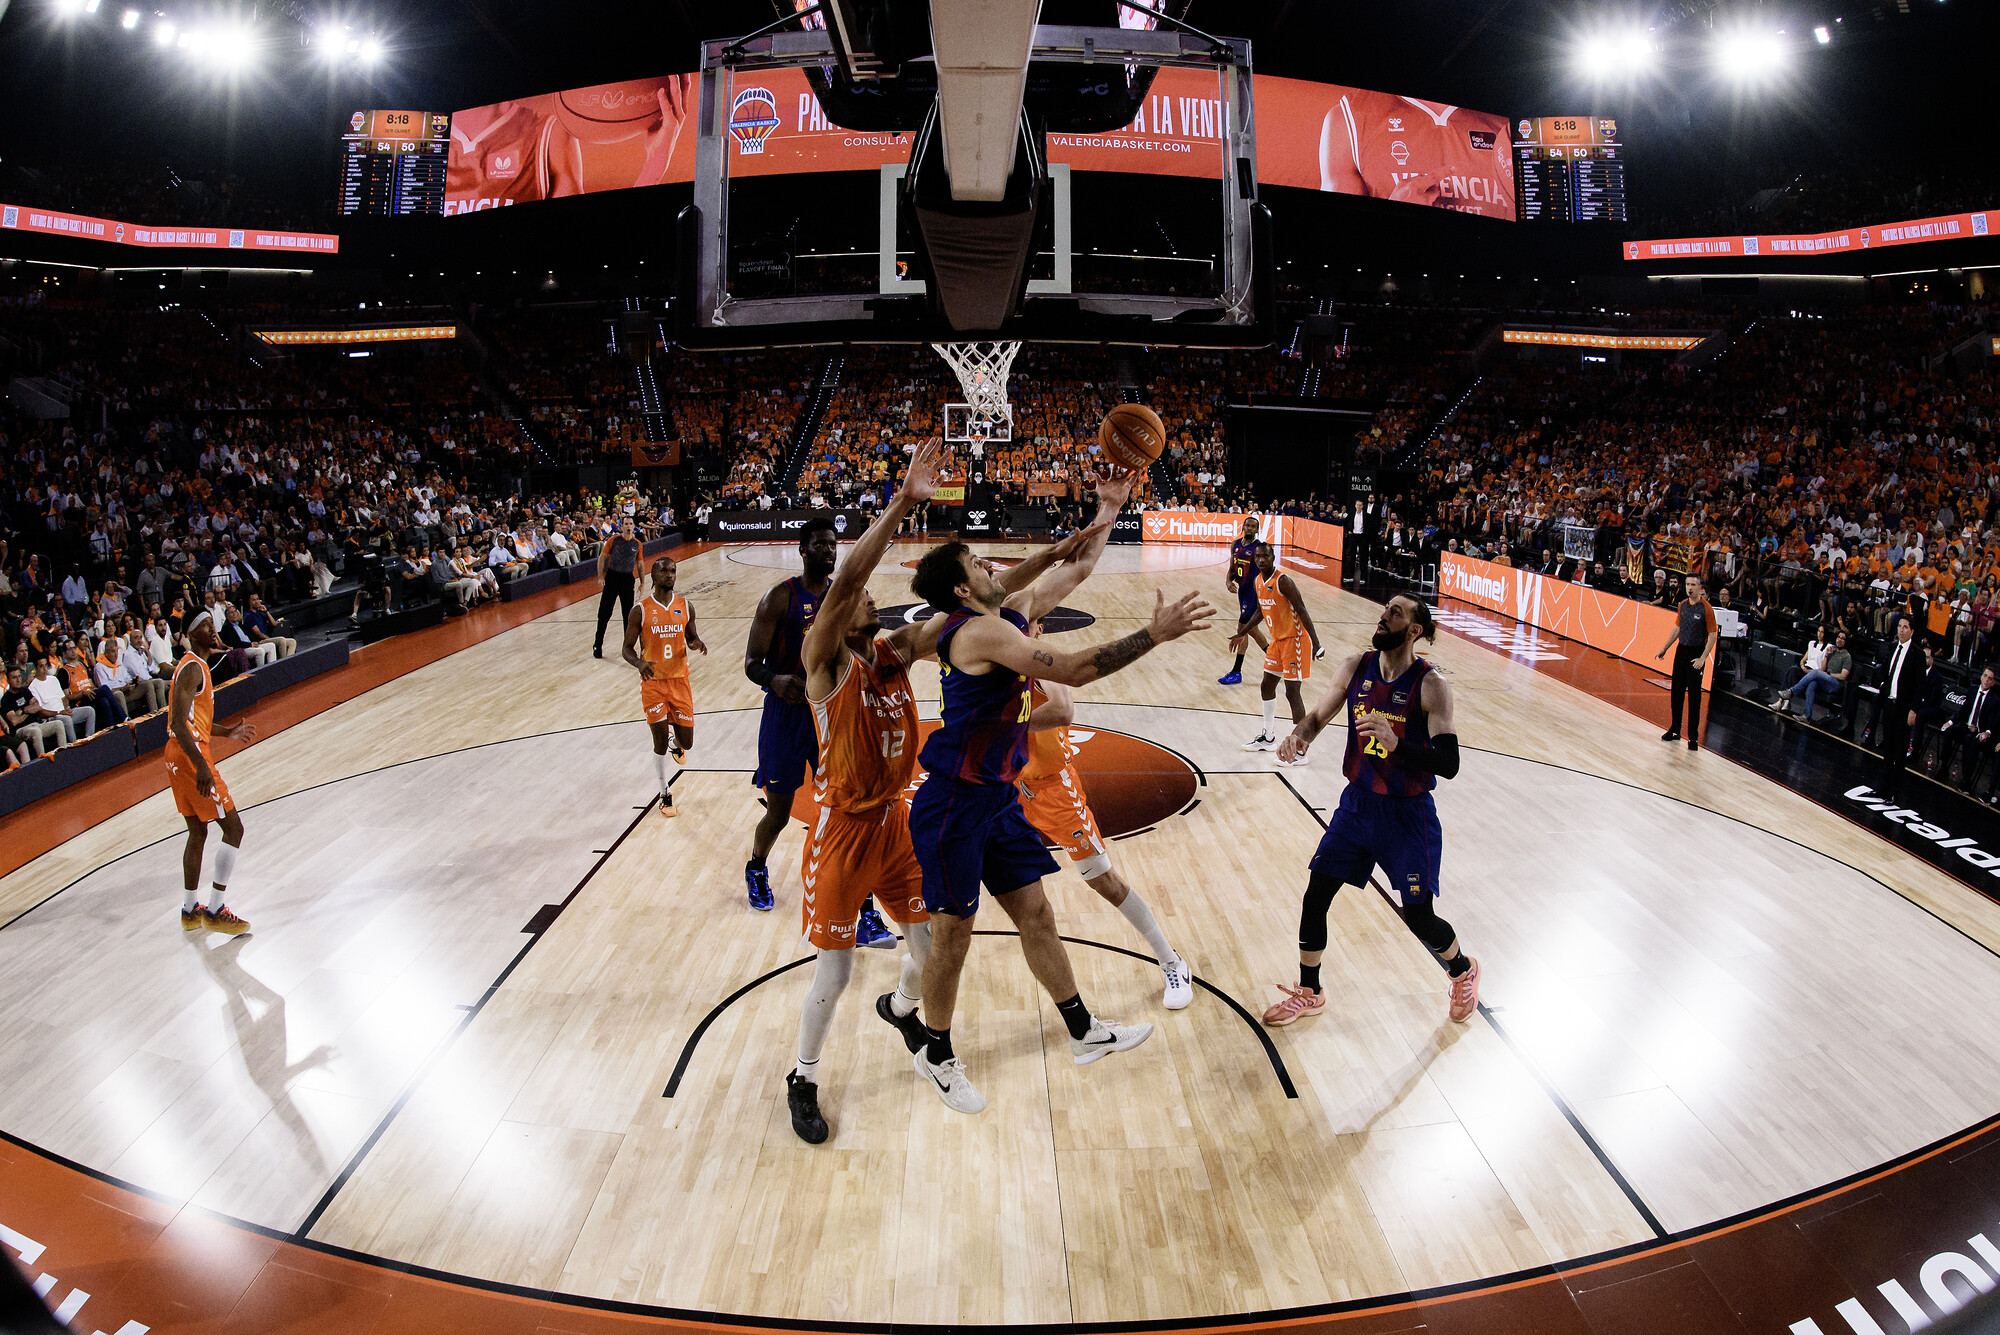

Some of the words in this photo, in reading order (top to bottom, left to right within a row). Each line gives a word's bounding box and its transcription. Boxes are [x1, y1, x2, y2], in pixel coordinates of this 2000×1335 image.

[386, 114, 409, 124] 8:18
[1152, 94, 1174, 134] LA
[1179, 97, 1230, 140] VENT
[1554, 120, 1576, 130] 8:18
[377, 142, 390, 151] 54
[401, 142, 415, 152] 50
[844, 136, 908, 147] CONSULTA
[1052, 136, 1191, 152] VALENCIABASKET.COM
[1549, 148, 1563, 158] 54
[1573, 148, 1587, 157] 50
[1111, 432, 1146, 466] Wilson
[726, 522, 771, 532] quironsalud
[1170, 518, 1238, 537] hummel
[1238, 567, 1242, 577] 0
[1456, 564, 1505, 602] hummel
[1266, 615, 1272, 627] 0
[651, 624, 683, 634] VALENCIA
[664, 644, 673, 659] 8
[1016, 690, 1031, 723] 20
[881, 730, 906, 758] 12
